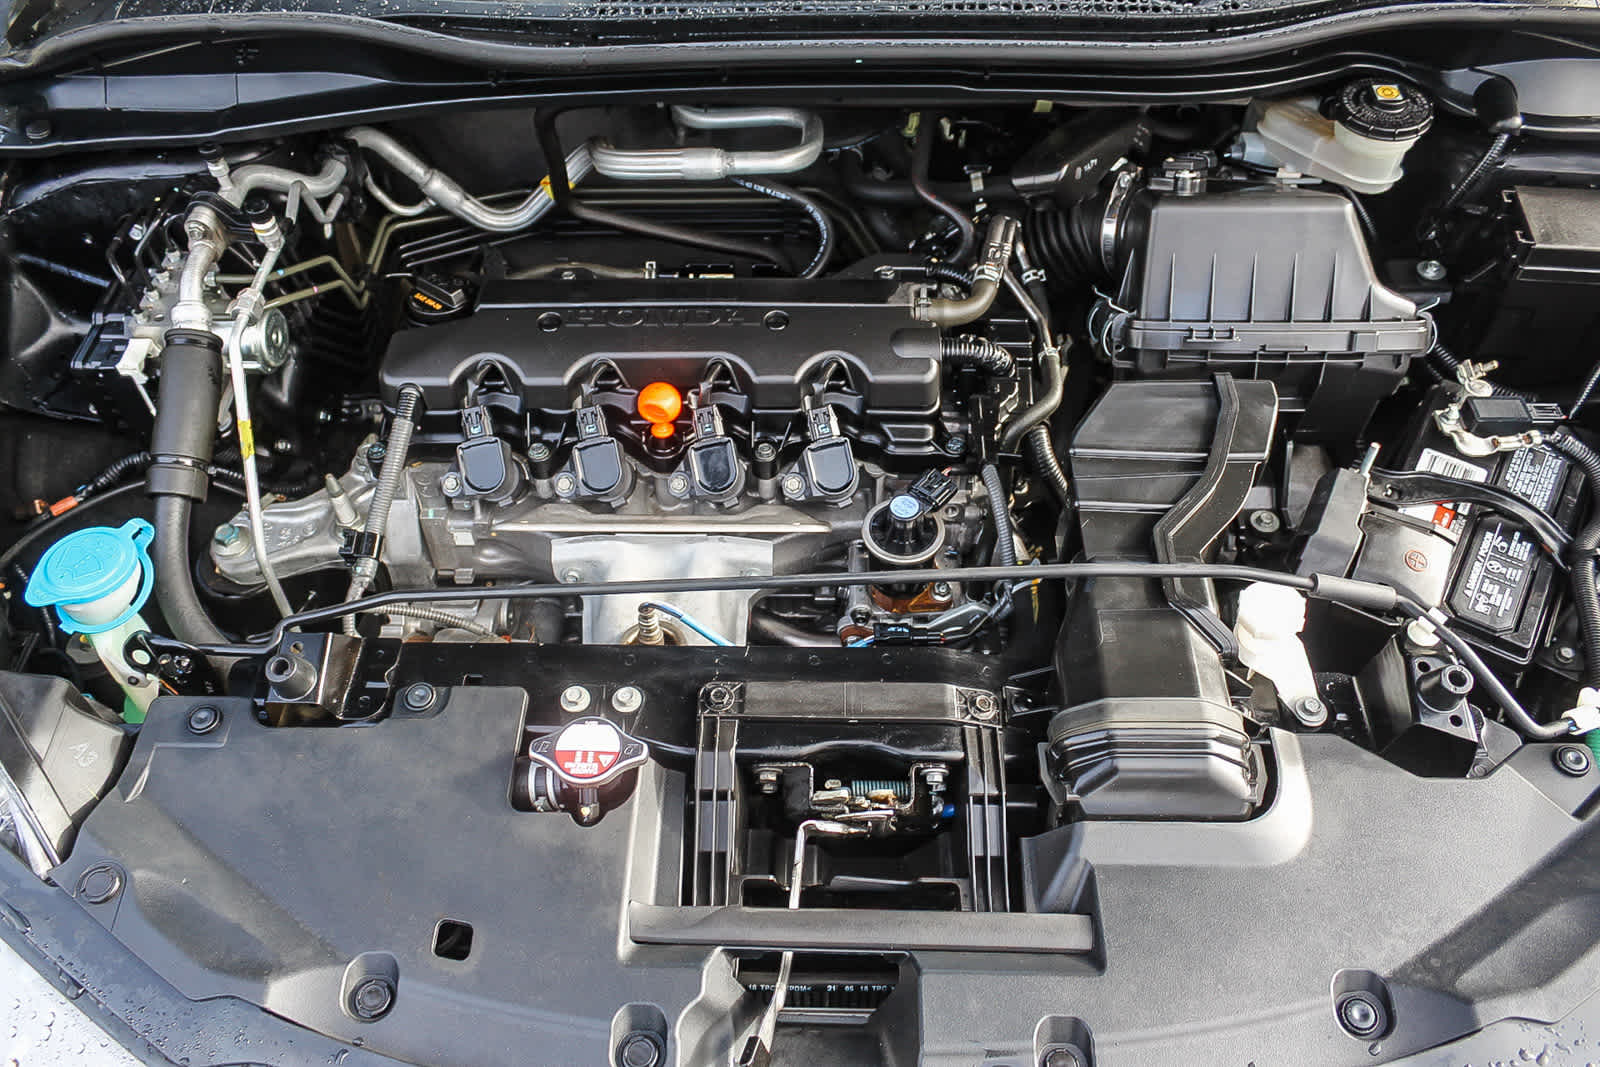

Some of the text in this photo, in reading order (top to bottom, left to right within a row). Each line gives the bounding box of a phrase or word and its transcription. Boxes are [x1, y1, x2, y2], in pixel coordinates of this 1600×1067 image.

[565, 308, 761, 327] HONDA
[1466, 560, 1484, 591] DANGER
[1478, 531, 1494, 556] POISON
